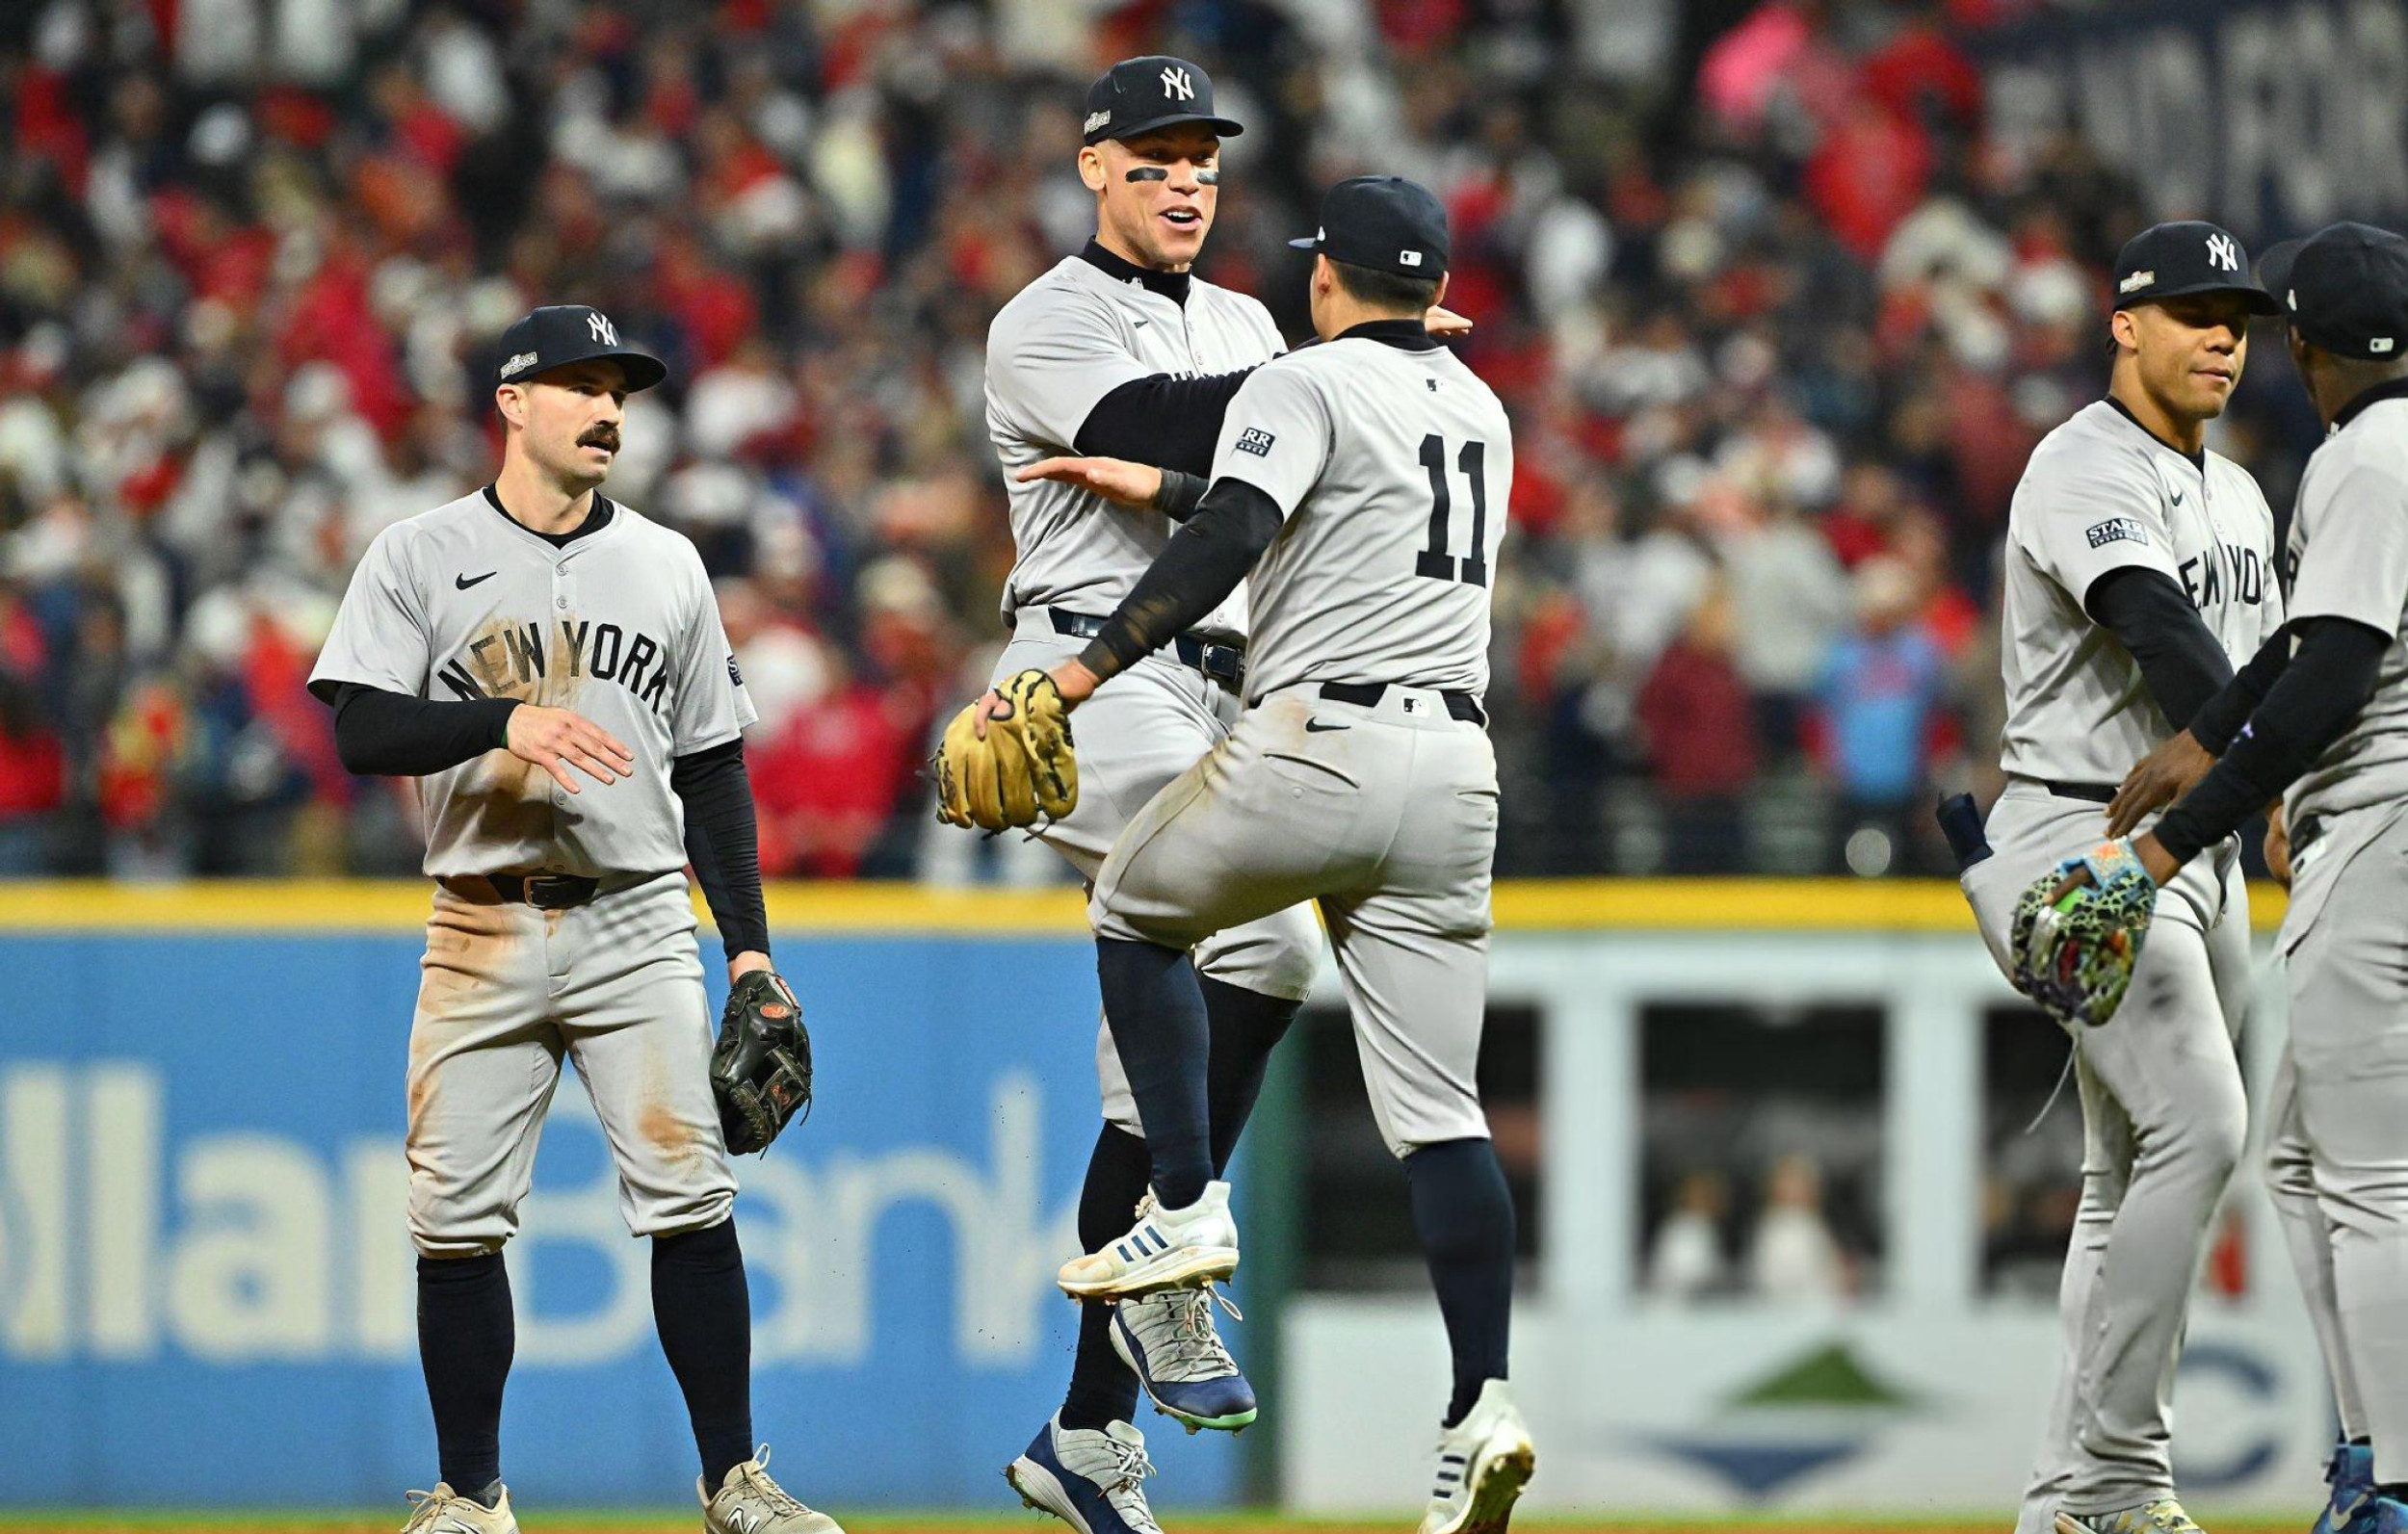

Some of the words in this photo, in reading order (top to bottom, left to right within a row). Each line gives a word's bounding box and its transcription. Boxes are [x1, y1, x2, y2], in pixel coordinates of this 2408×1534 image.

[1160, 66, 1195, 101] NY
[2206, 233, 2238, 272] NY
[587, 311, 618, 348] NY
[1415, 433, 1486, 588] 11
[2088, 518, 2145, 540] STARR
[2179, 547, 2220, 608] EW
[2226, 544, 2262, 605] YO
[437, 622, 545, 700] NEW
[562, 620, 668, 715] YORK
[0, 1059, 412, 1358] llar
